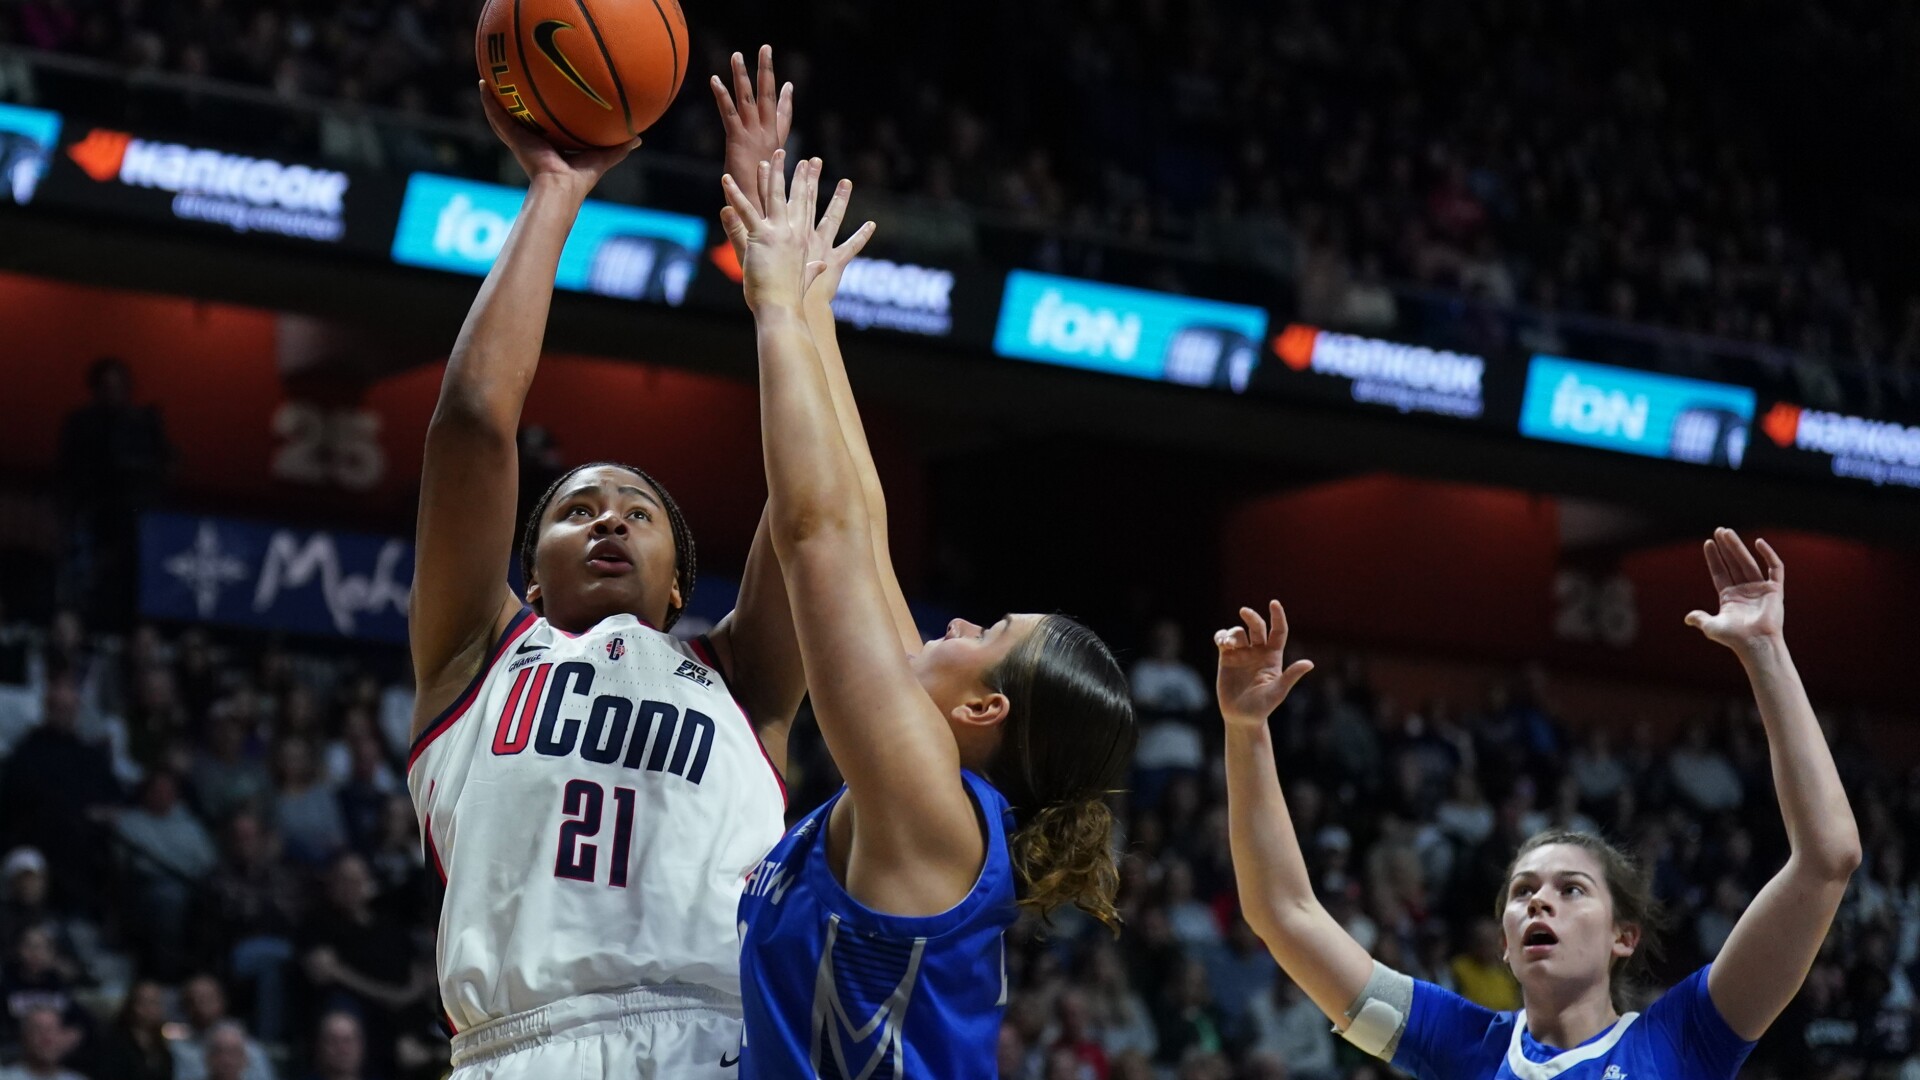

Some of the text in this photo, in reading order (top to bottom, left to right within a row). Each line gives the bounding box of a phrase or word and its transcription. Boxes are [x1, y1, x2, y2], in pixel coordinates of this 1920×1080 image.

[272, 402, 386, 490] 25
[676, 667, 714, 688] EAST
[680, 659, 709, 677] BIG
[554, 778, 636, 888] 21
